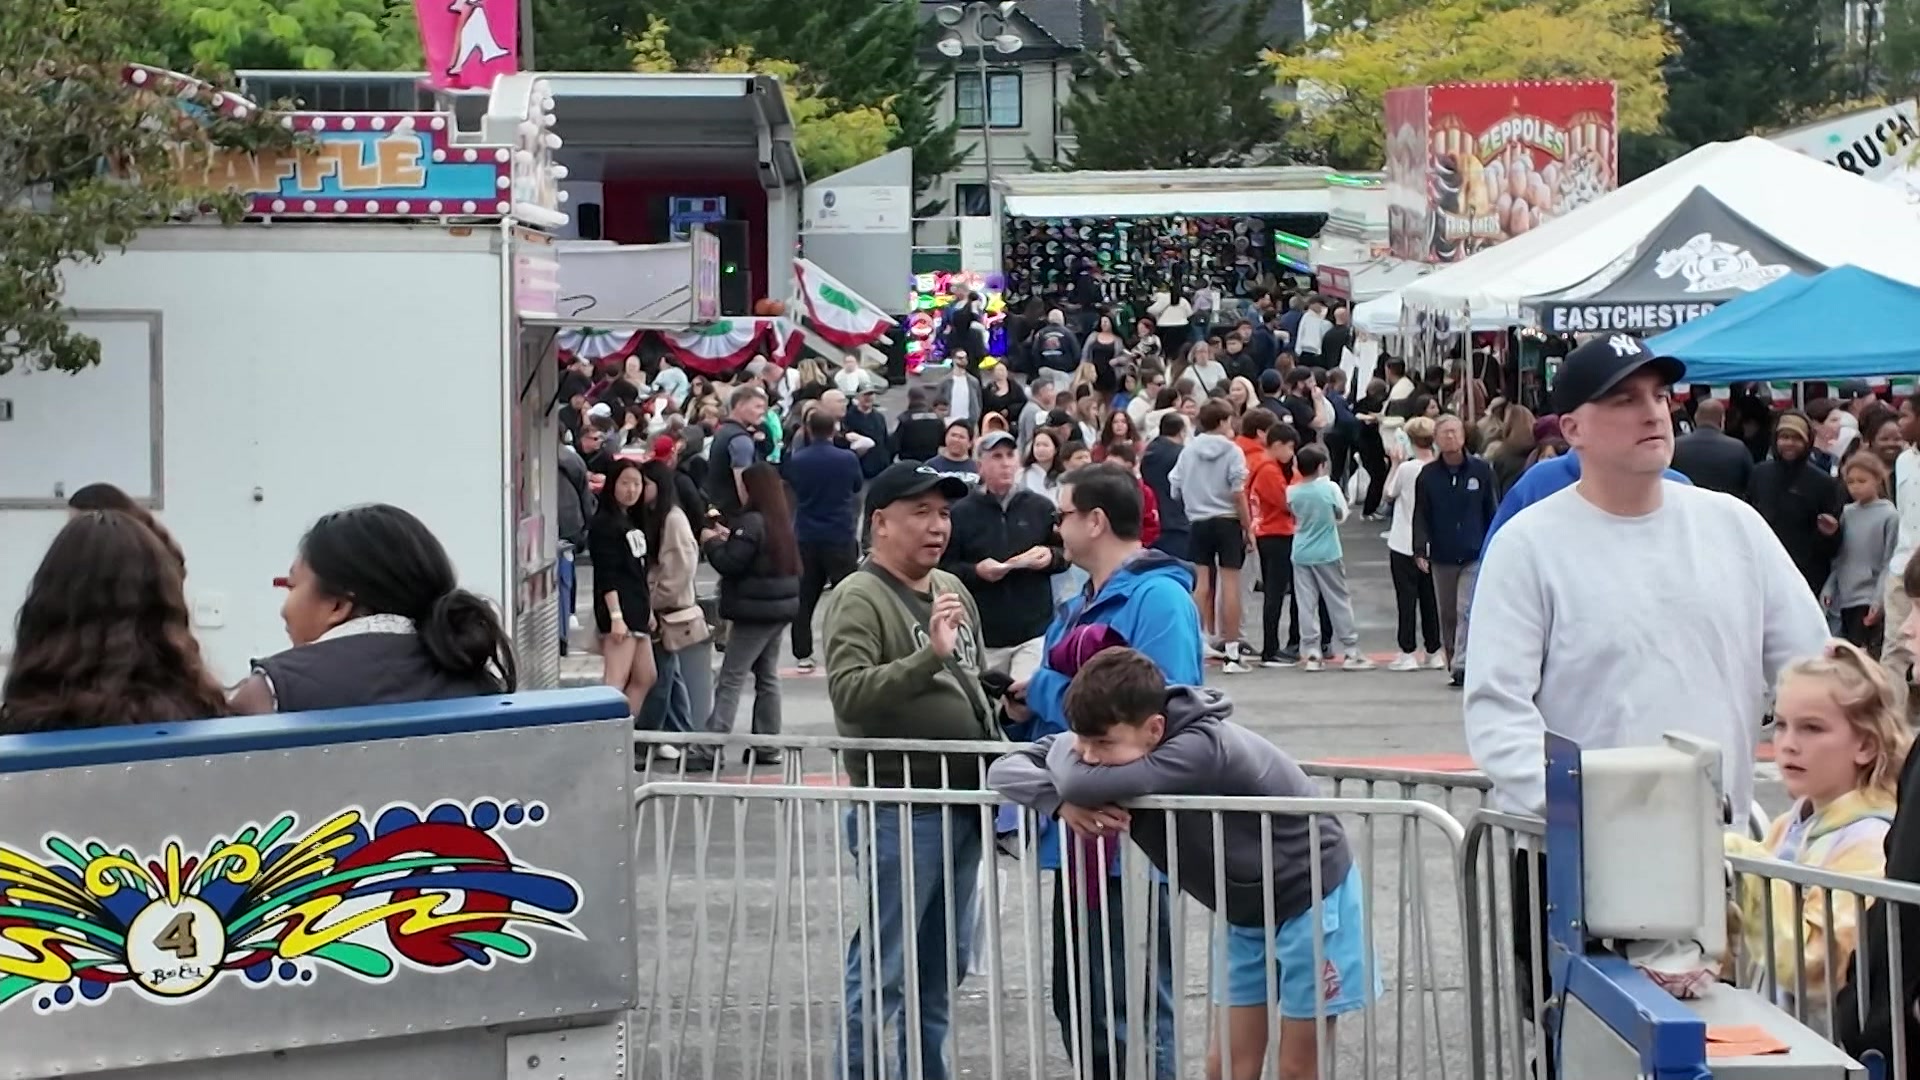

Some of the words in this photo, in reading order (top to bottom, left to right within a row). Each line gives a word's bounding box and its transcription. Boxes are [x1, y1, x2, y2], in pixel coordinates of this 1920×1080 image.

[1480, 118, 1564, 158] ZEPPOLES
[1824, 114, 1916, 177] RUSH
[1608, 333, 1641, 357] NY
[152, 911, 198, 959] 4
